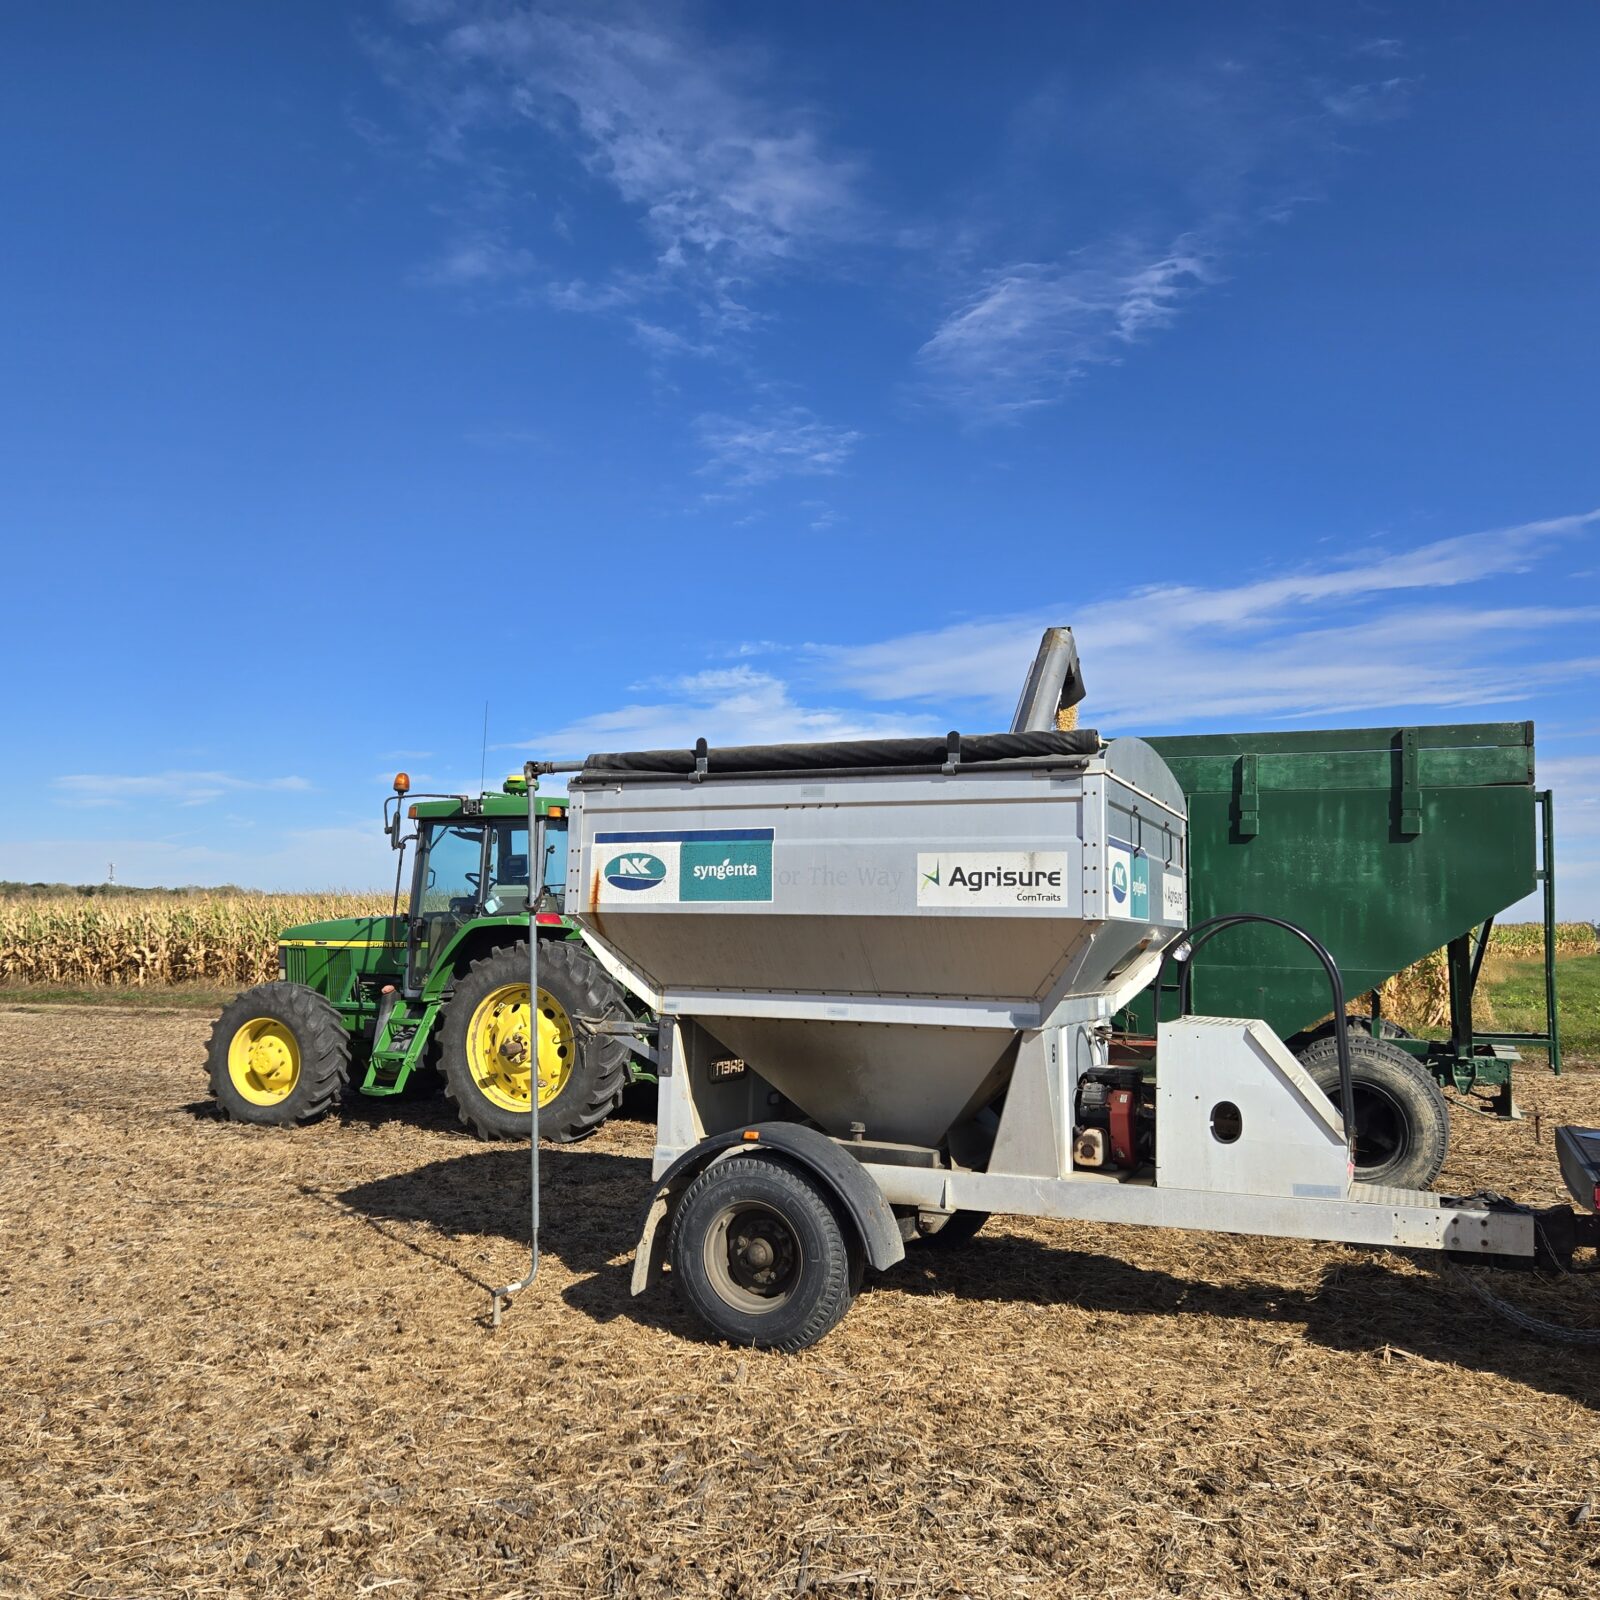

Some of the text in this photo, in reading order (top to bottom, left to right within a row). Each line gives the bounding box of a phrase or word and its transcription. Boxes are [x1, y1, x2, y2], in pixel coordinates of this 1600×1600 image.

[619, 858, 652, 874] NK
[693, 861, 757, 880] syngenta
[807, 865, 848, 886] The
[857, 866, 904, 893] Way
[948, 866, 1061, 891] Agrisure
